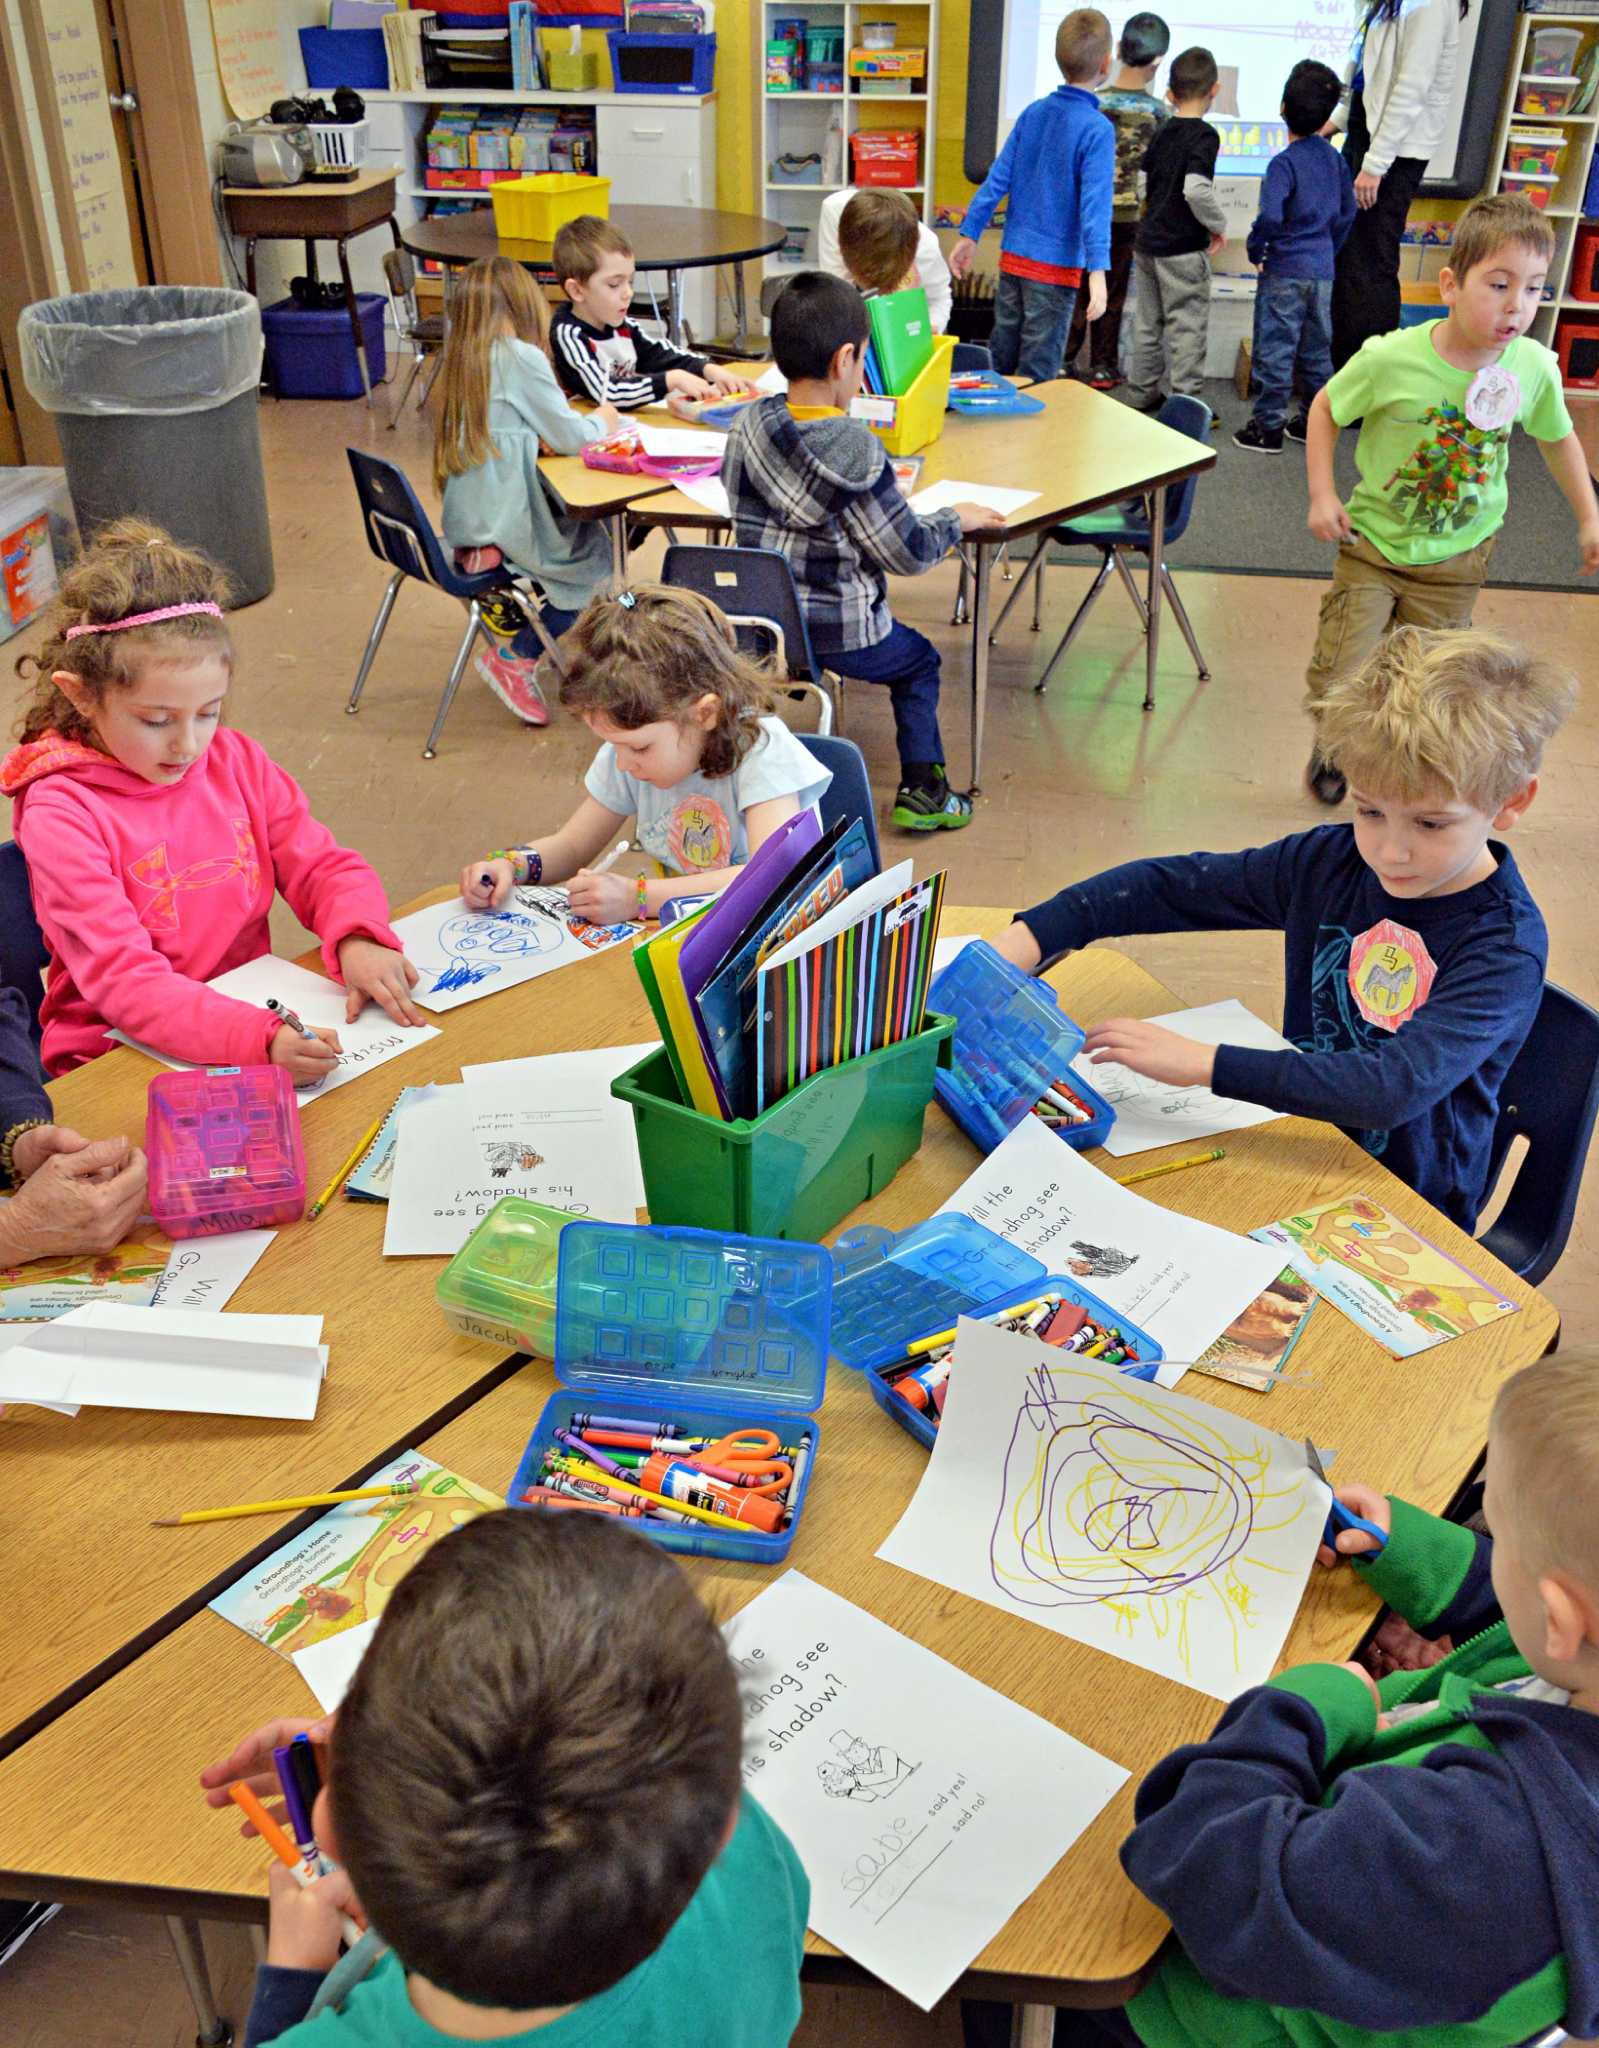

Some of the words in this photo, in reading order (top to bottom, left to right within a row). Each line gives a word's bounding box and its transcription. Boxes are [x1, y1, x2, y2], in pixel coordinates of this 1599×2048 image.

[454, 1188, 537, 1202] shadow?
[548, 1185, 573, 1196] his
[986, 1186, 1013, 1207] the
[1037, 1183, 1059, 1204] see
[433, 1209, 466, 1218] see
[181, 1278, 219, 1306] Will
[458, 1316, 518, 1347] Jacob
[253, 1582, 262, 1591] A
[260, 1545, 309, 1586] Groundhog's
[308, 1529, 331, 1549] Home
[306, 1543, 331, 1565] homes
[330, 1532, 344, 1545] are
[283, 1572, 306, 1593] called
[796, 1641, 829, 1671] see
[768, 1673, 847, 1751] shadow?
[928, 1796, 948, 1816] said
[949, 1773, 969, 1798] yes!
[952, 1810, 972, 1832] said
[971, 1793, 985, 1812] no!
